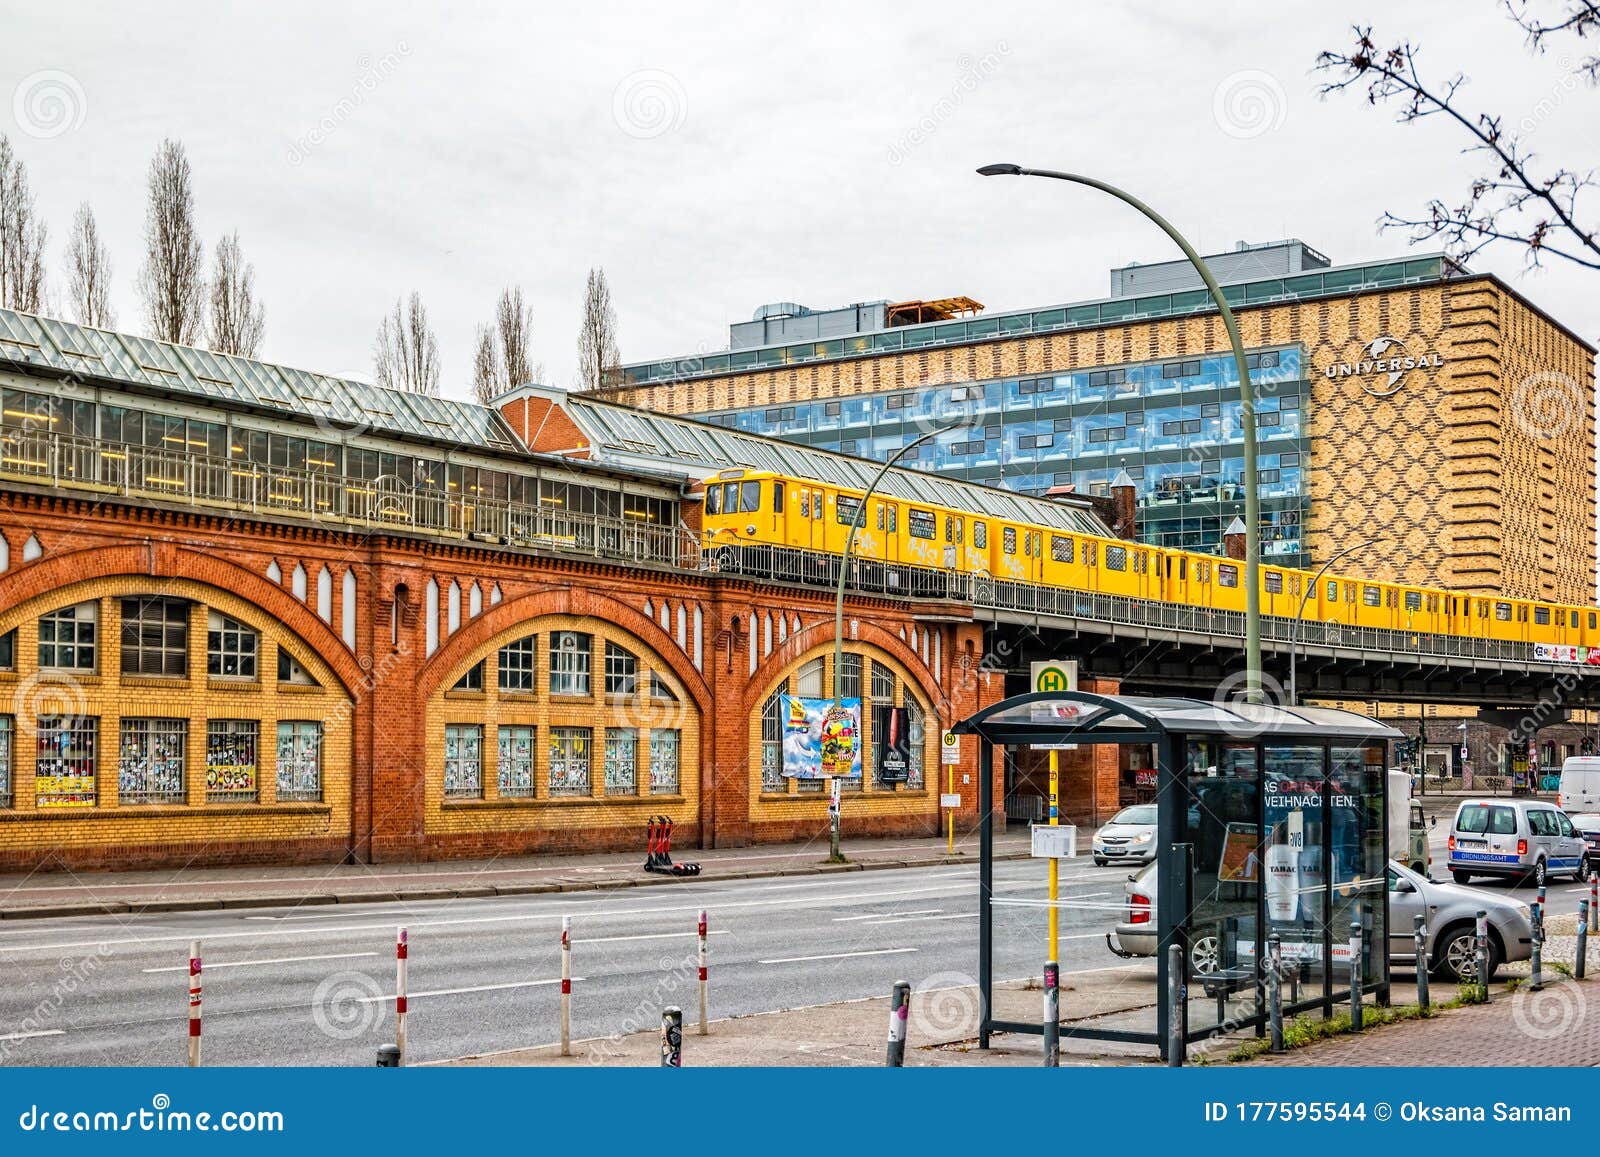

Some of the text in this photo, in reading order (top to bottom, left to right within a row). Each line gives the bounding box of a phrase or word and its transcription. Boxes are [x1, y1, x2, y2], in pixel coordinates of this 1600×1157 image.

[1326, 354, 1444, 378] UNIVERSAL
[1044, 675, 1059, 691] H
[1461, 852, 1507, 862] ORDNUNGSAMT
